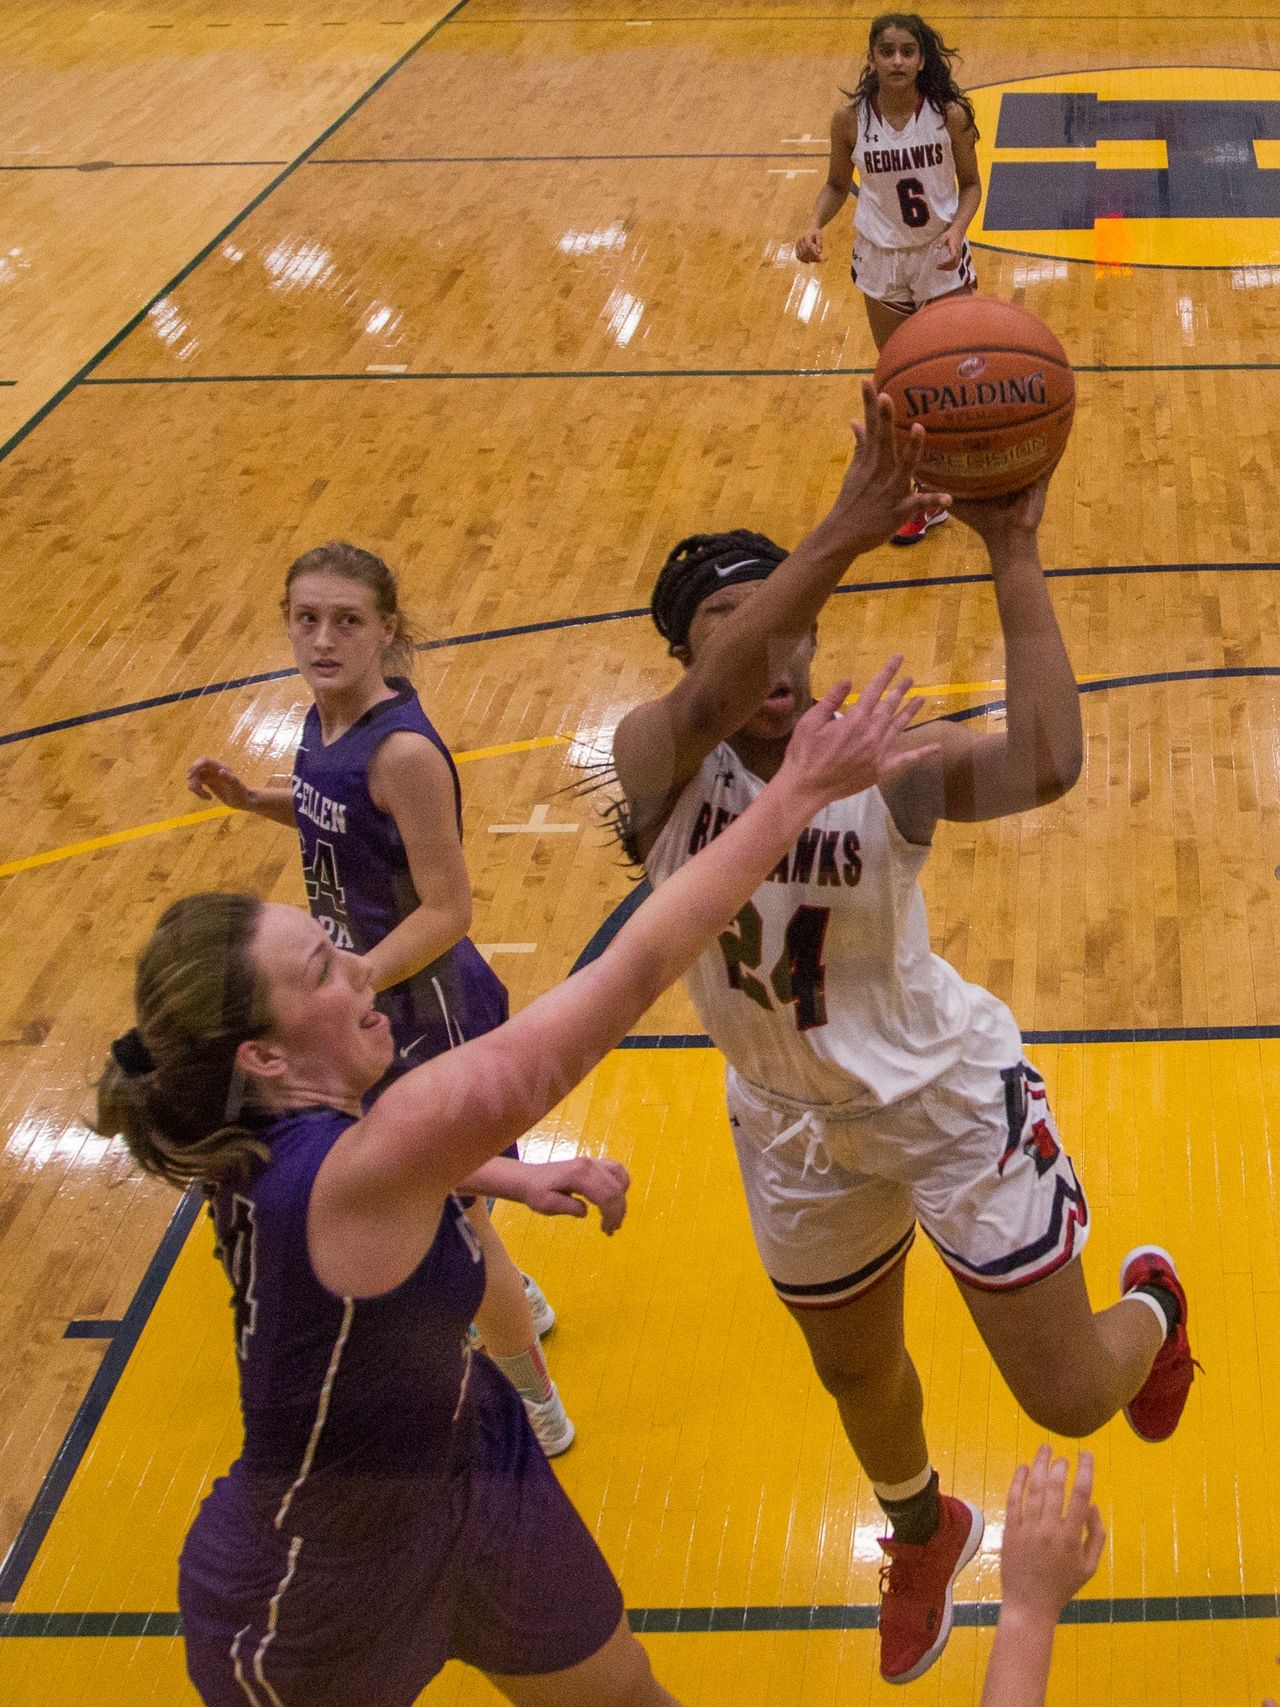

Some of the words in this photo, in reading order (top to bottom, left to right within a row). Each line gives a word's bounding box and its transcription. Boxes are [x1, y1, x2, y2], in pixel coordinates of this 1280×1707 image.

[863, 143, 943, 173] REDHAWKS
[896, 177, 930, 228] 6
[903, 372, 1046, 418] SPALDING
[718, 900, 831, 1031] 24
